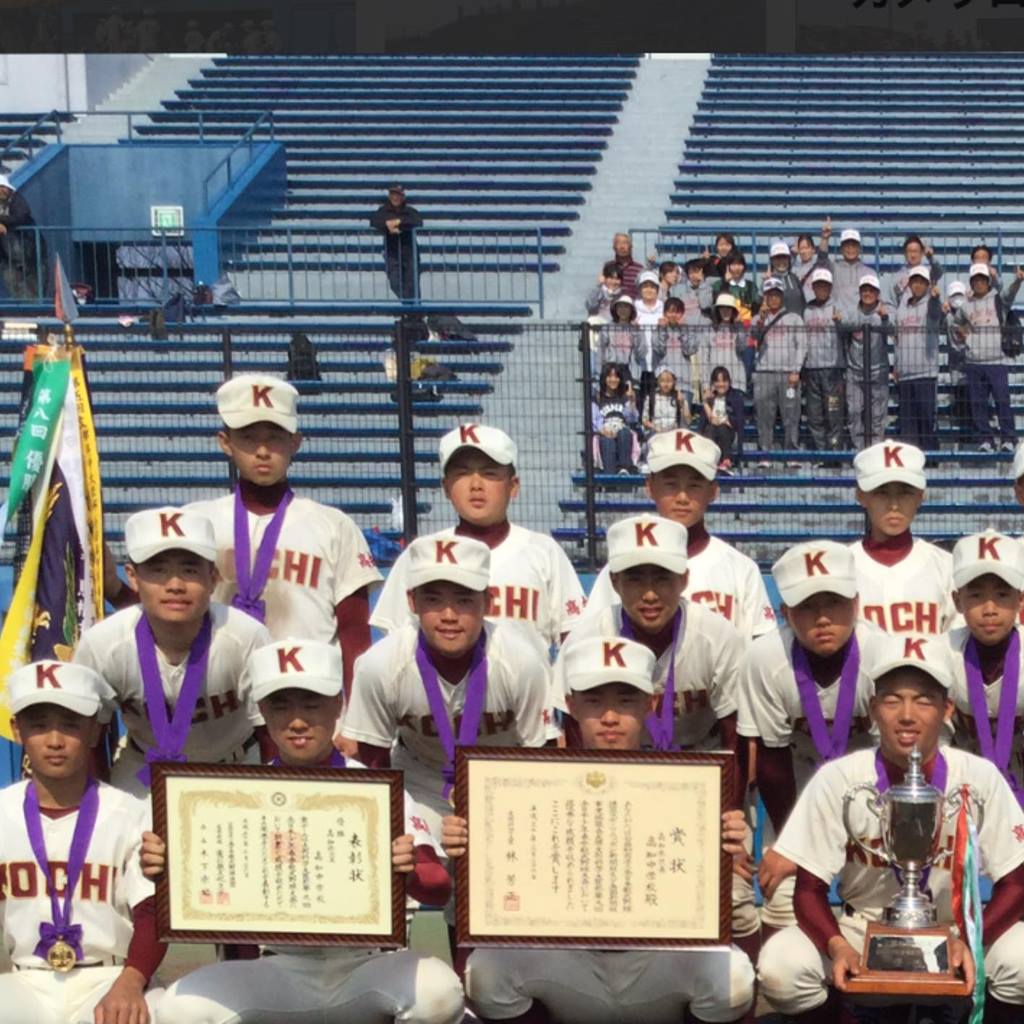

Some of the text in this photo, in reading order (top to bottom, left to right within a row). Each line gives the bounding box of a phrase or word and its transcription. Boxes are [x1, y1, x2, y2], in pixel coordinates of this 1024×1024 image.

[252, 384, 274, 409] K
[459, 424, 480, 444] K
[675, 431, 696, 453] K
[883, 445, 904, 468] K
[159, 512, 185, 537] K
[634, 522, 658, 547] K
[435, 540, 458, 564] K
[978, 536, 1001, 561] K
[803, 550, 829, 577] K
[276, 646, 304, 674] K
[603, 641, 627, 668] K
[903, 637, 927, 661] K
[35, 663, 62, 689] K
